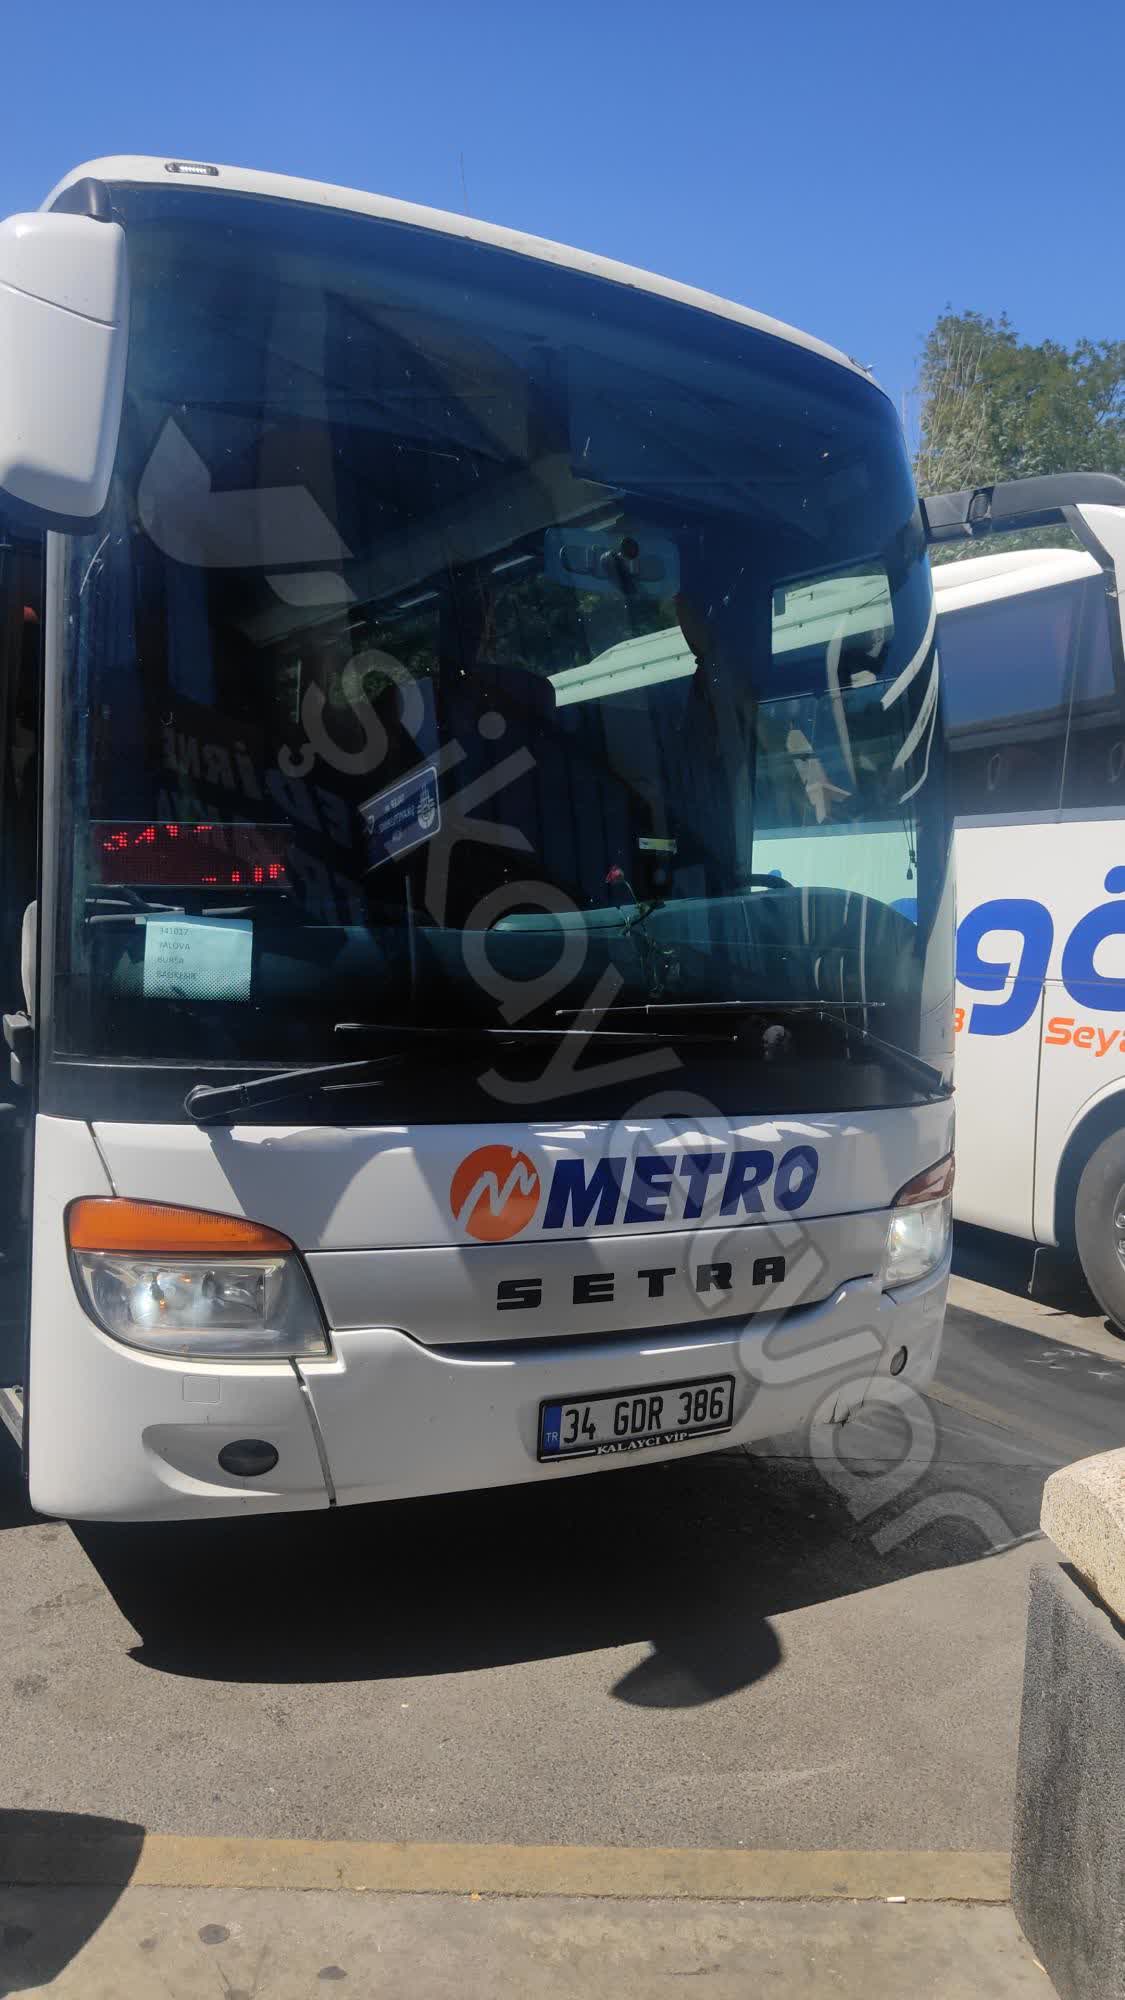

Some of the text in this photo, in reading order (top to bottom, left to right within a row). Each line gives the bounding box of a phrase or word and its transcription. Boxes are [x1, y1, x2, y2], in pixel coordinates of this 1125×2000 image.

[1045, 1017, 1125, 1057] Sey
[542, 1145, 819, 1230] METRO
[496, 1256, 786, 1311] SETRA
[546, 1431, 559, 1442] TR
[563, 1387, 725, 1444] 34 GDR 386
[596, 1431, 689, 1455] KALAYCI VİP
